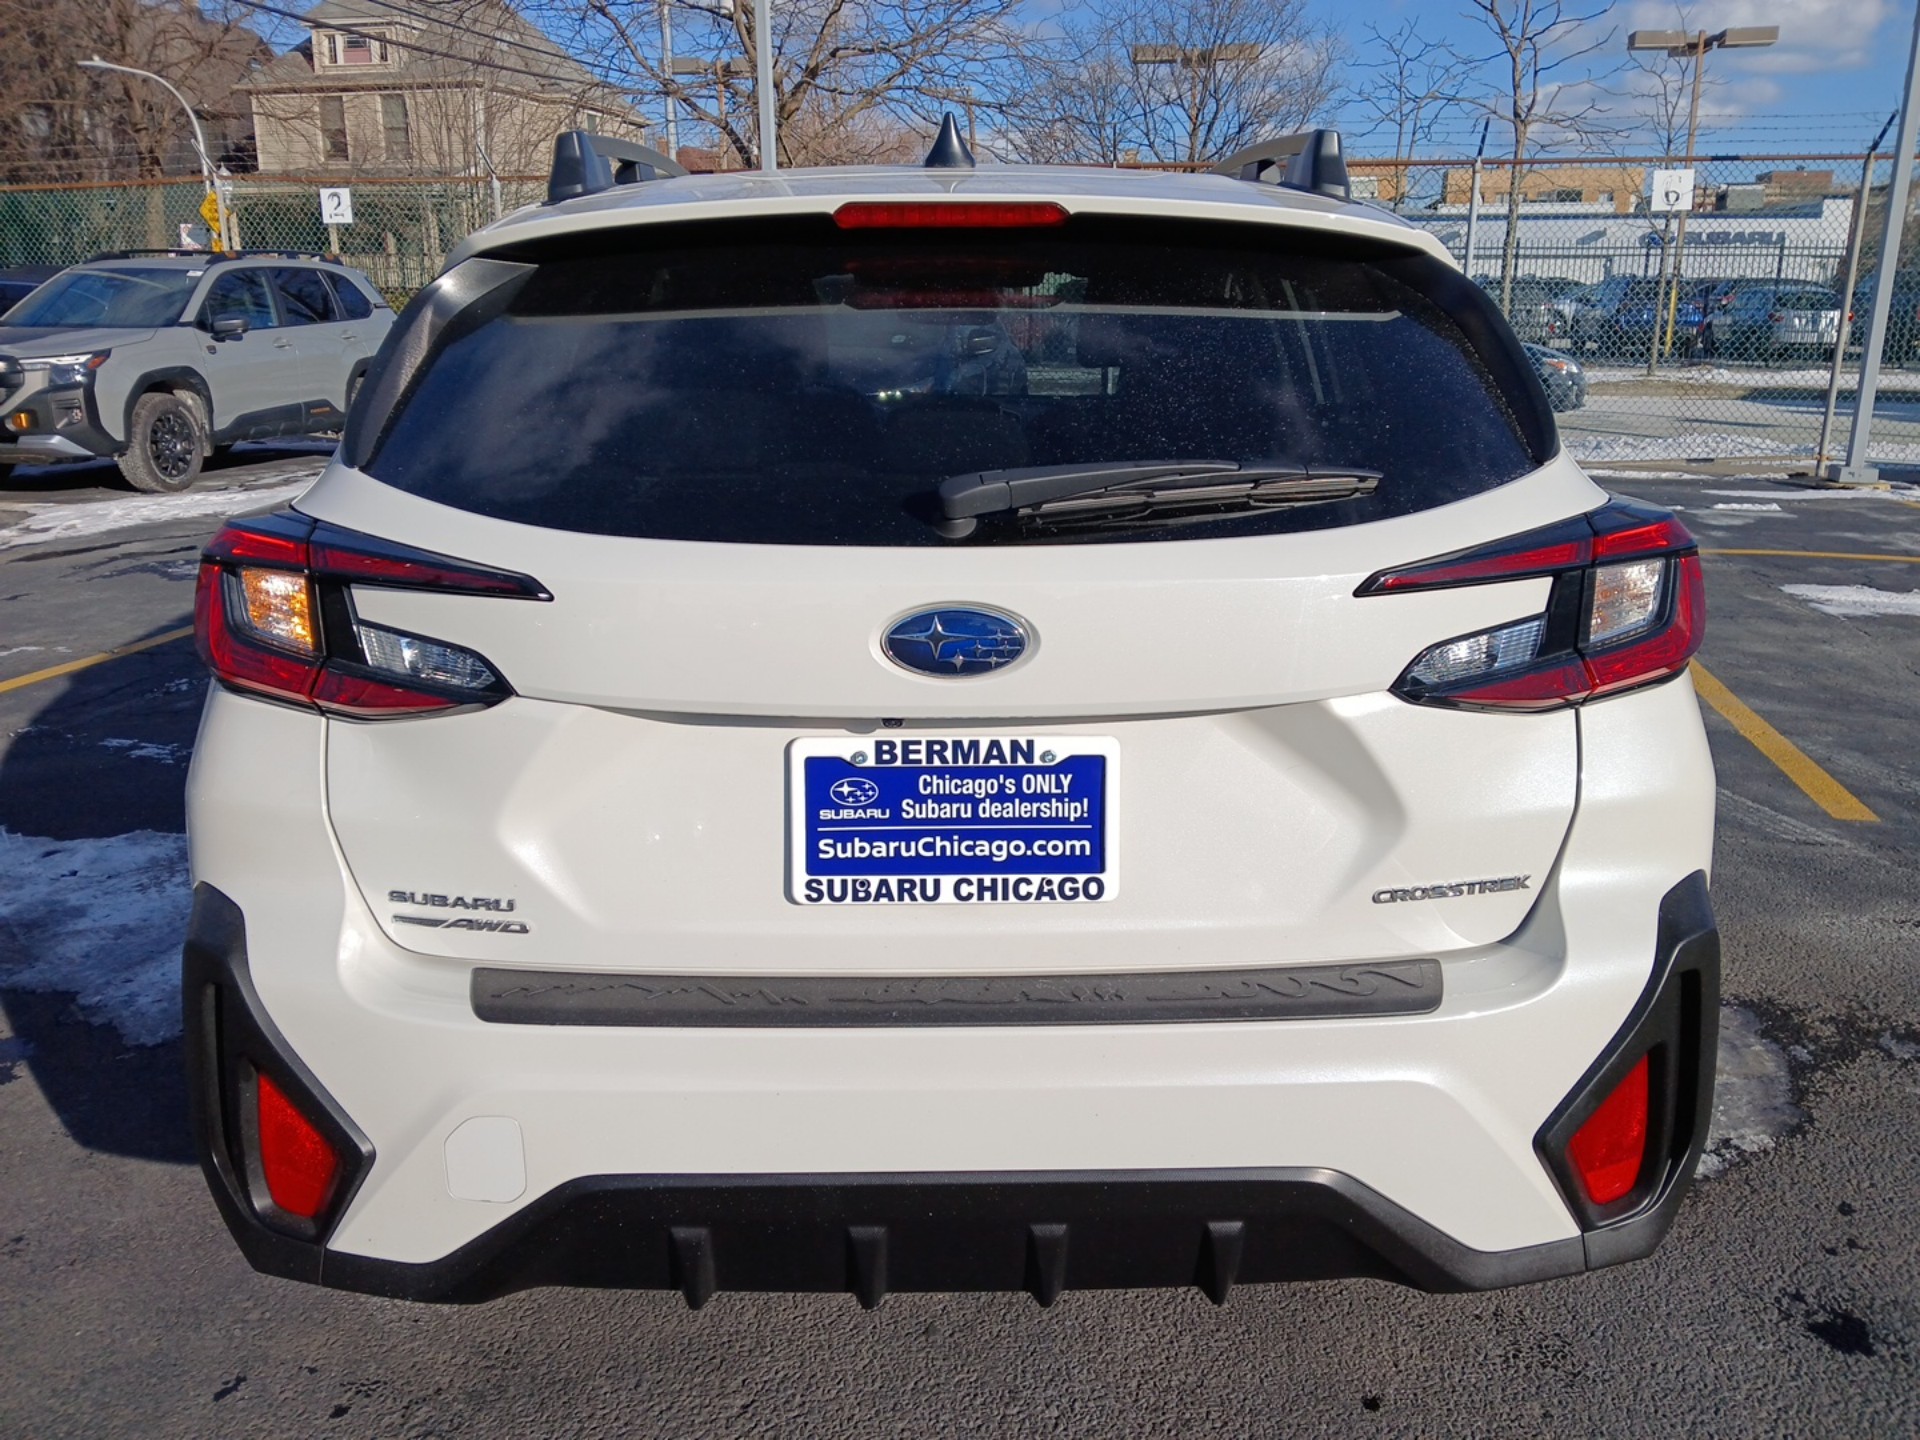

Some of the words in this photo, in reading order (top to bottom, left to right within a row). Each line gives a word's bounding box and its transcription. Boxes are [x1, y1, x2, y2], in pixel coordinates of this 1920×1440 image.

[874, 740, 1035, 765] BERMAN
[918, 774, 1016, 798] Chicago's
[1022, 774, 1072, 794] ONLY
[819, 808, 890, 820] SUBARU
[901, 799, 972, 819] Subaru
[978, 798, 1089, 821] dealership!
[817, 836, 1091, 861] SubaruChicago.com
[388, 890, 516, 912] SUBARU
[804, 878, 941, 903] SUBARU
[952, 876, 1105, 902] CHICAGO
[1371, 874, 1531, 904] CROSSTREK
